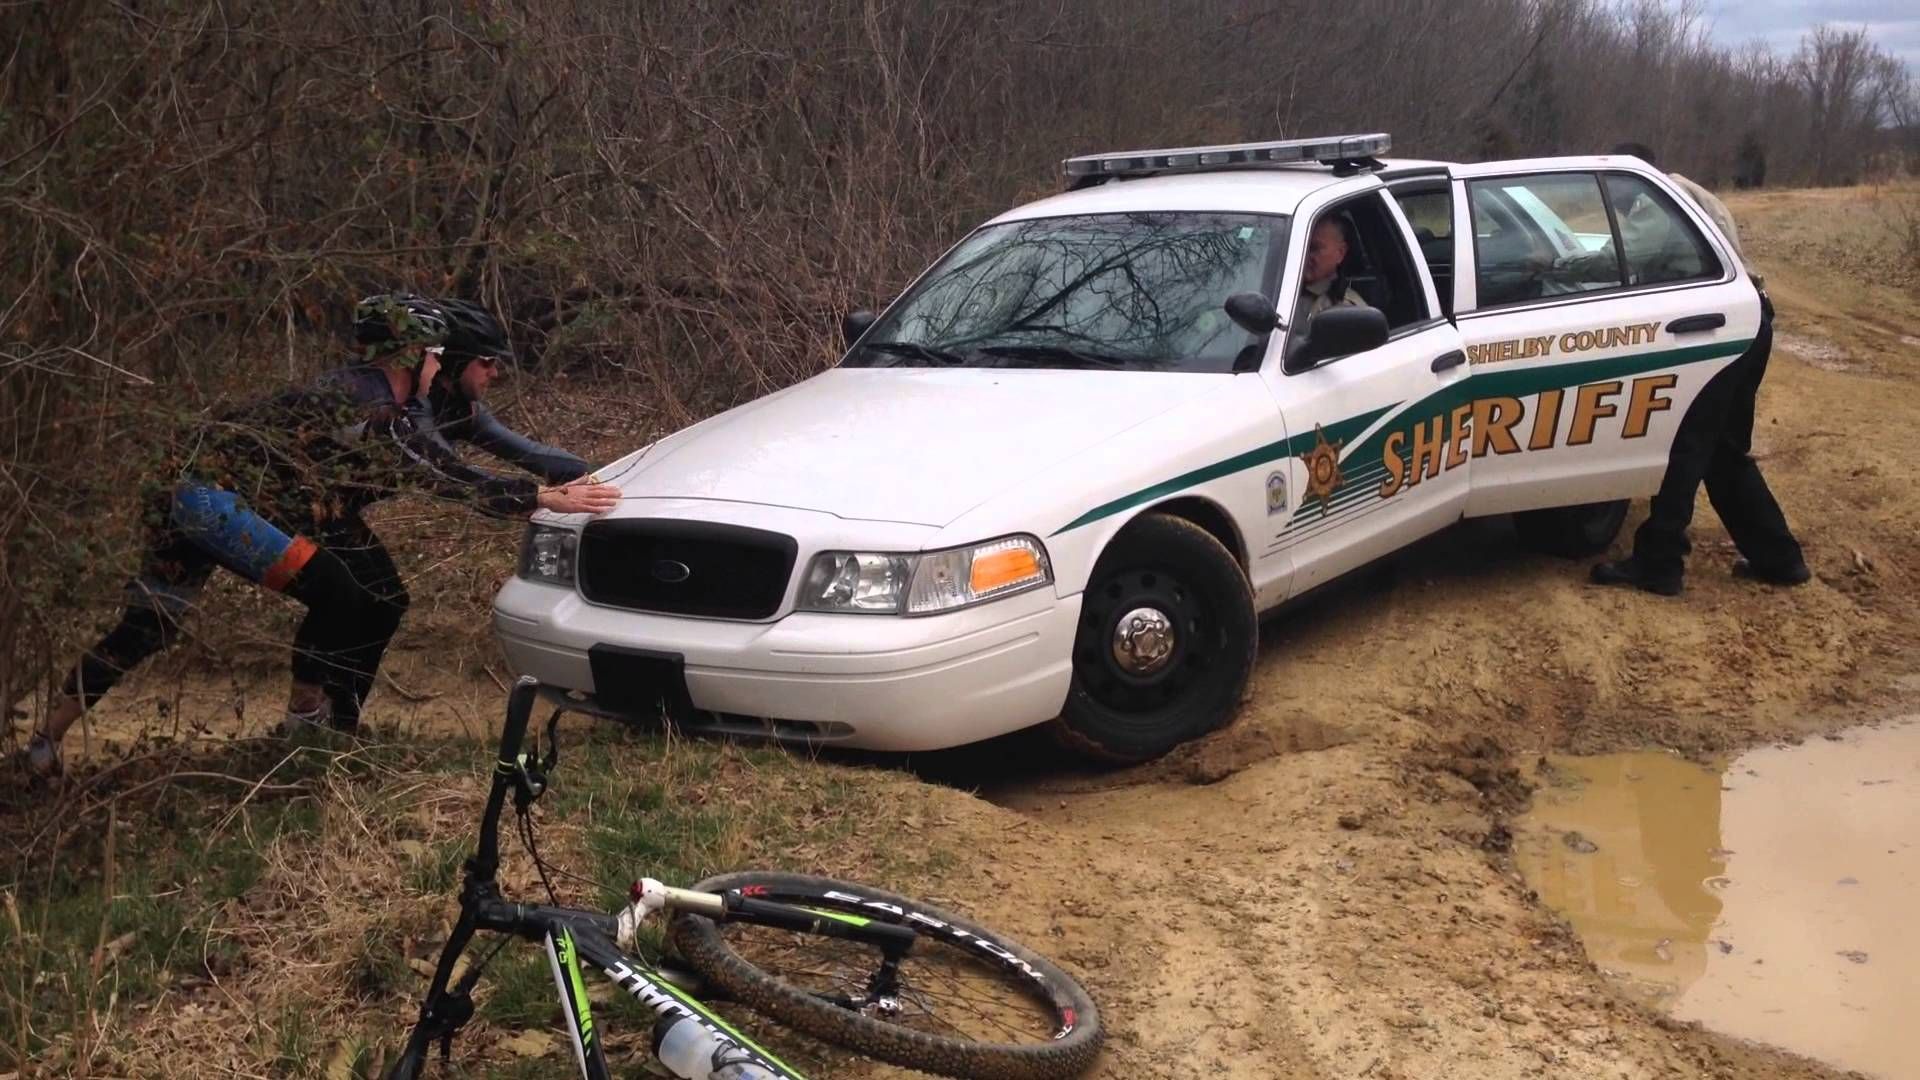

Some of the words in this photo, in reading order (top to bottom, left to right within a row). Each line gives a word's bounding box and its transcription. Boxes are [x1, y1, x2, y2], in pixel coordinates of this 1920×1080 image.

[1466, 335, 1556, 365] SHELBY
[1559, 321, 1661, 352] COUNTY
[1379, 374, 1679, 498] SHERIFF
[823, 890, 1045, 979] EASTON
